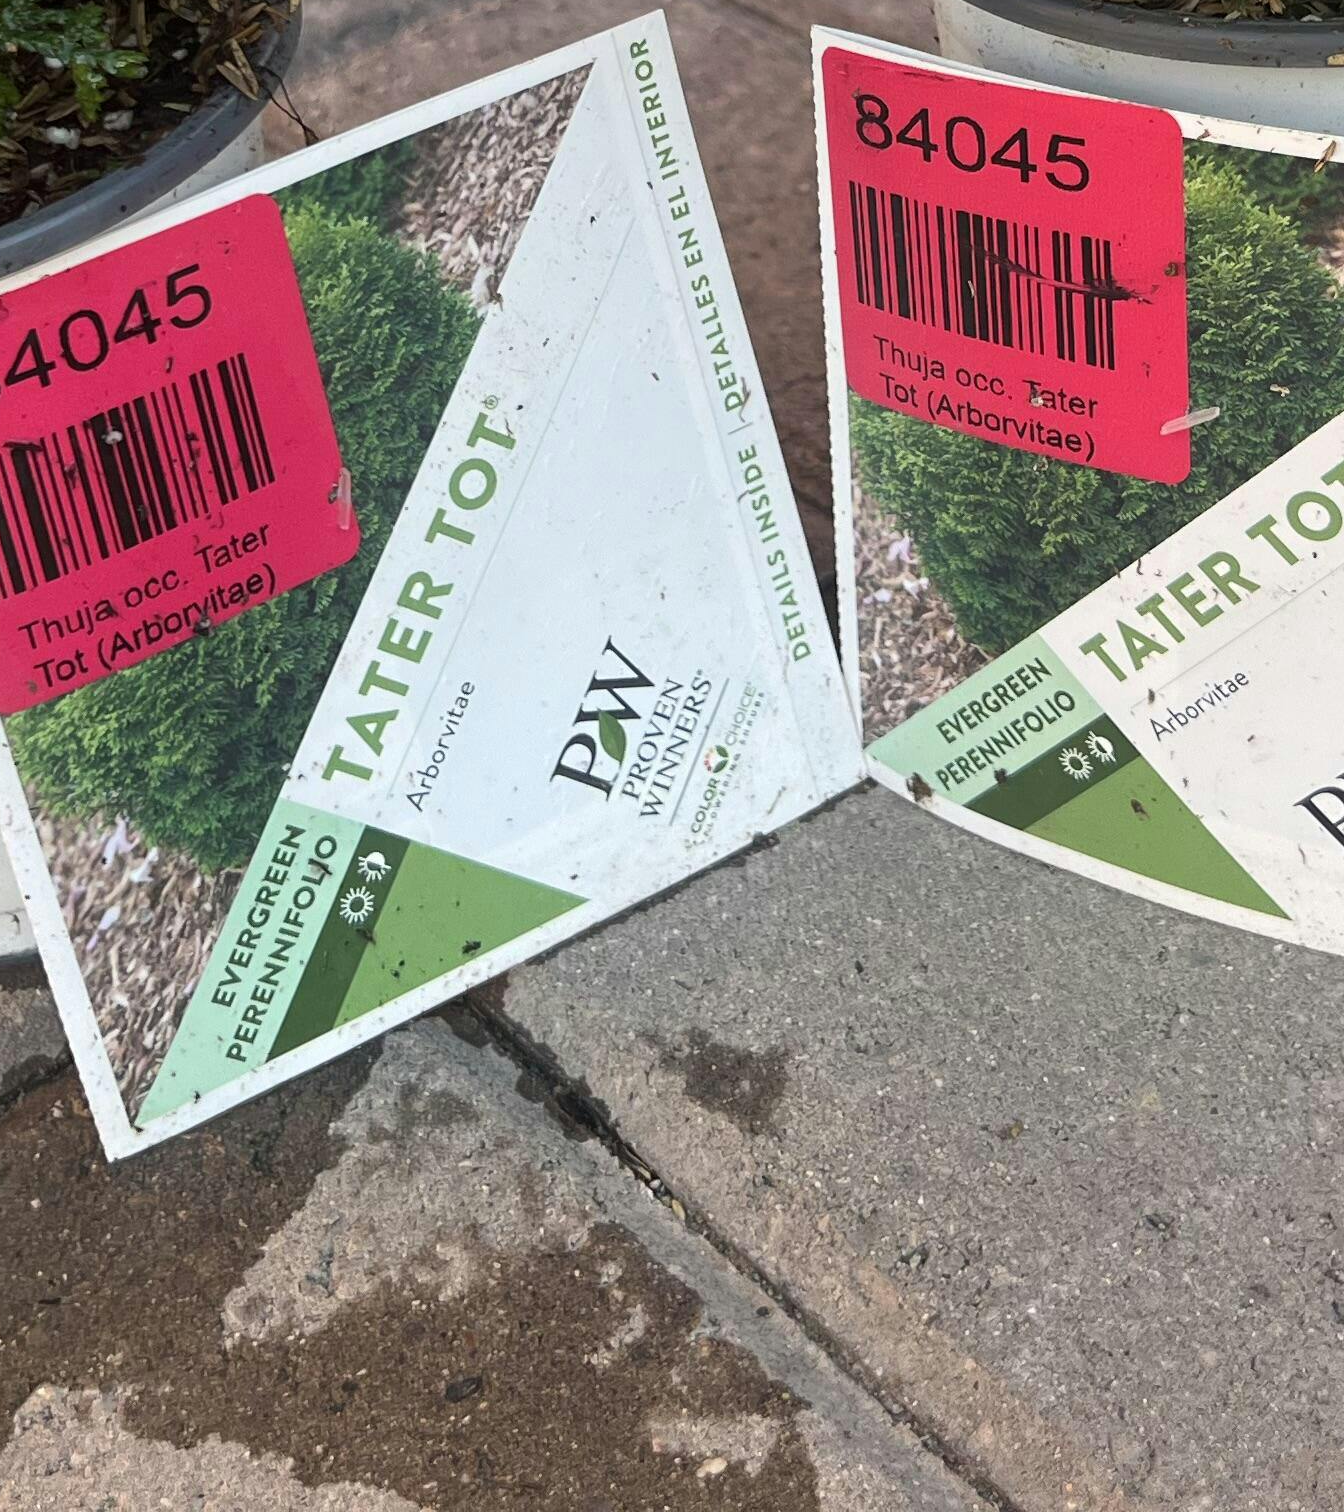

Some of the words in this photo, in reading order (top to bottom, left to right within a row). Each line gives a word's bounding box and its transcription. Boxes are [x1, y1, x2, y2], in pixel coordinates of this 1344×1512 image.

[630, 38, 679, 181] INTERIOR
[855, 93, 1091, 193] 84045
[667, 185, 690, 221] EL
[678, 228, 703, 269] EN
[691, 274, 743, 413] DETALLES
[873, 334, 946, 381] Thuja
[955, 368, 1013, 400] occ.
[1022, 379, 1098, 418] Tater
[879, 372, 919, 408] Tot
[927, 390, 1095, 462] (Arborvitae)
[738, 444, 779, 543] INSIDE
[18, 600, 114, 650] Thuja
[123, 570, 190, 608] occ.
[193, 524, 270, 574] Tater
[34, 649, 89, 688] Tot
[97, 562, 276, 671] (Arborvitae)
[767, 549, 812, 662] DETAILS
[1078, 550, 1261, 683] TATER
[321, 571, 454, 781] TATER
[935, 657, 1053, 745] EVERGREEN
[1150, 672, 1249, 741] Arborvitae
[406, 680, 475, 812] Arborvitae
[621, 676, 684, 799] PROVEN
[935, 690, 1076, 791] PERENNIFOLIO
[691, 778, 720, 834] COLOR
[211, 824, 306, 1008] EVERGREEN
[225, 835, 337, 1062] PERENNIFOLIO
